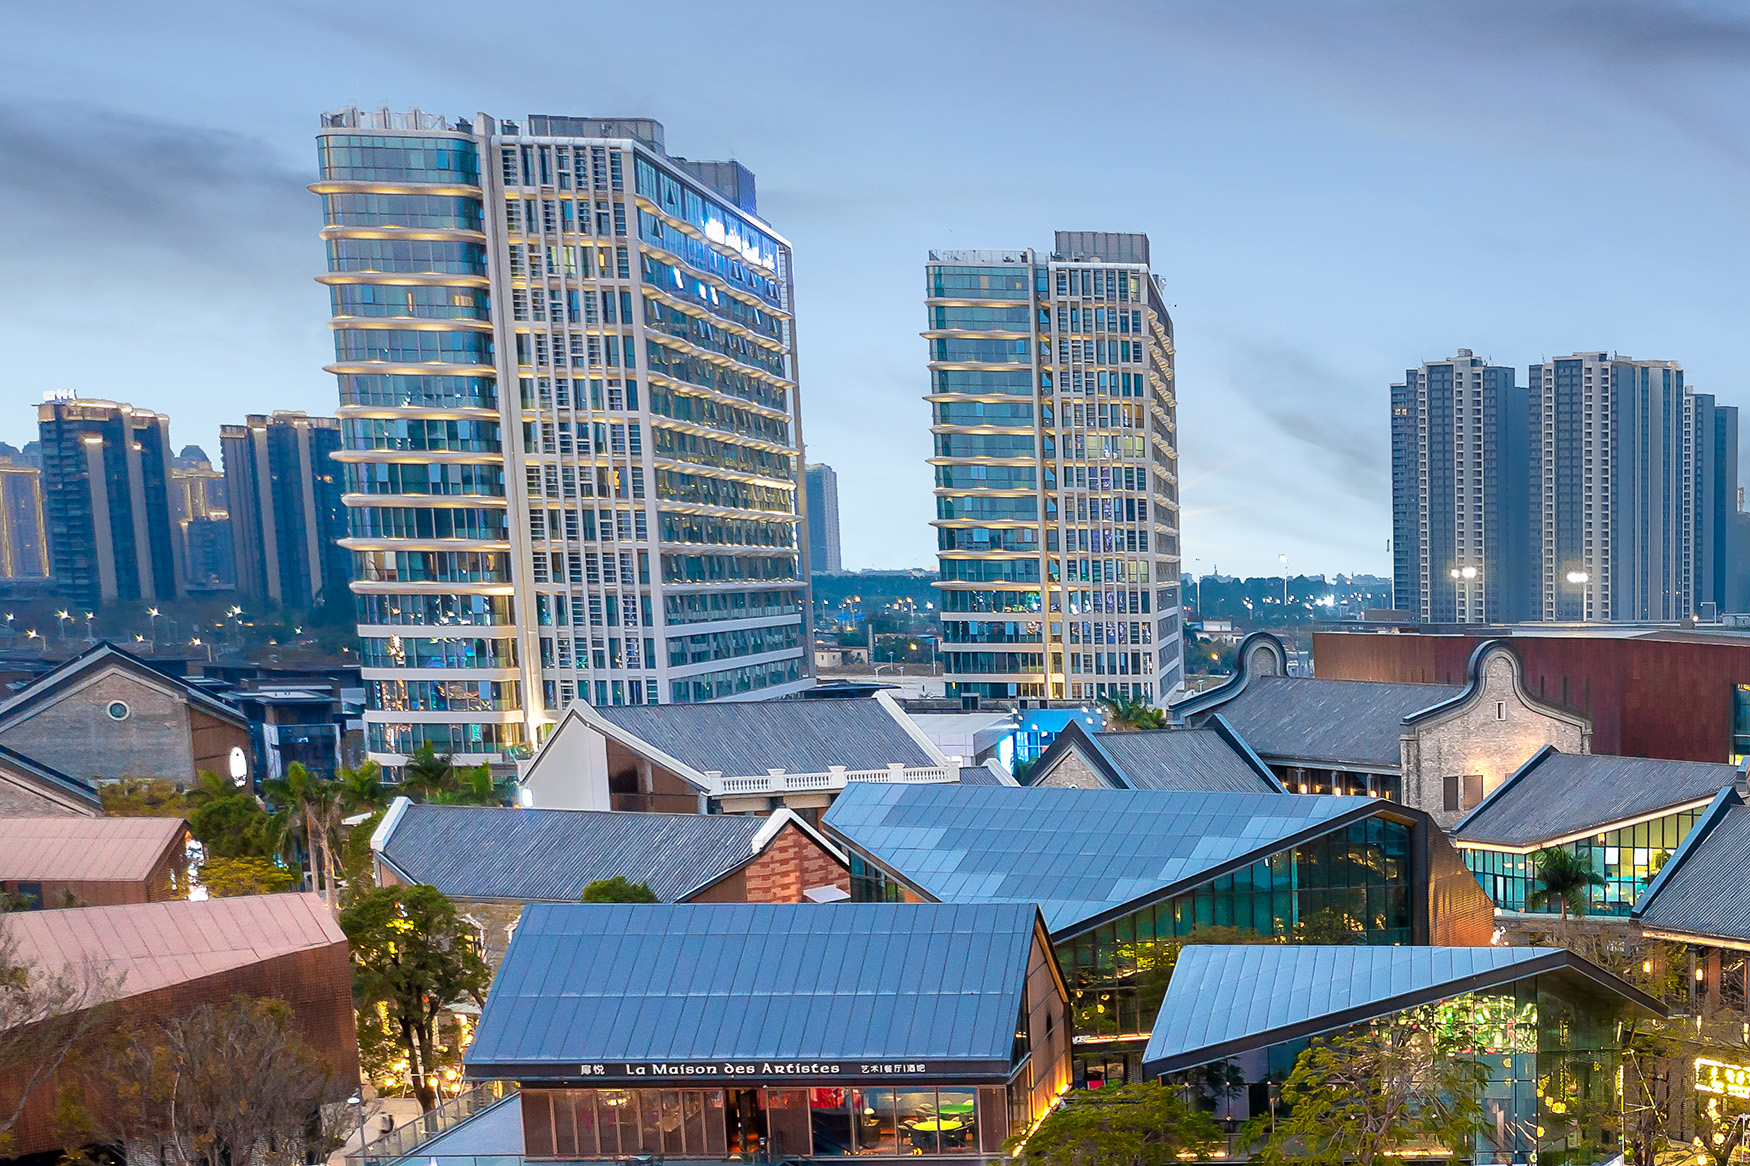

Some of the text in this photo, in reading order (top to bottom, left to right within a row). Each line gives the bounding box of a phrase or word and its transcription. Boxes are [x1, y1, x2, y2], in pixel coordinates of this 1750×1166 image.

[626, 1063, 840, 1075] La Maison des Artistes
